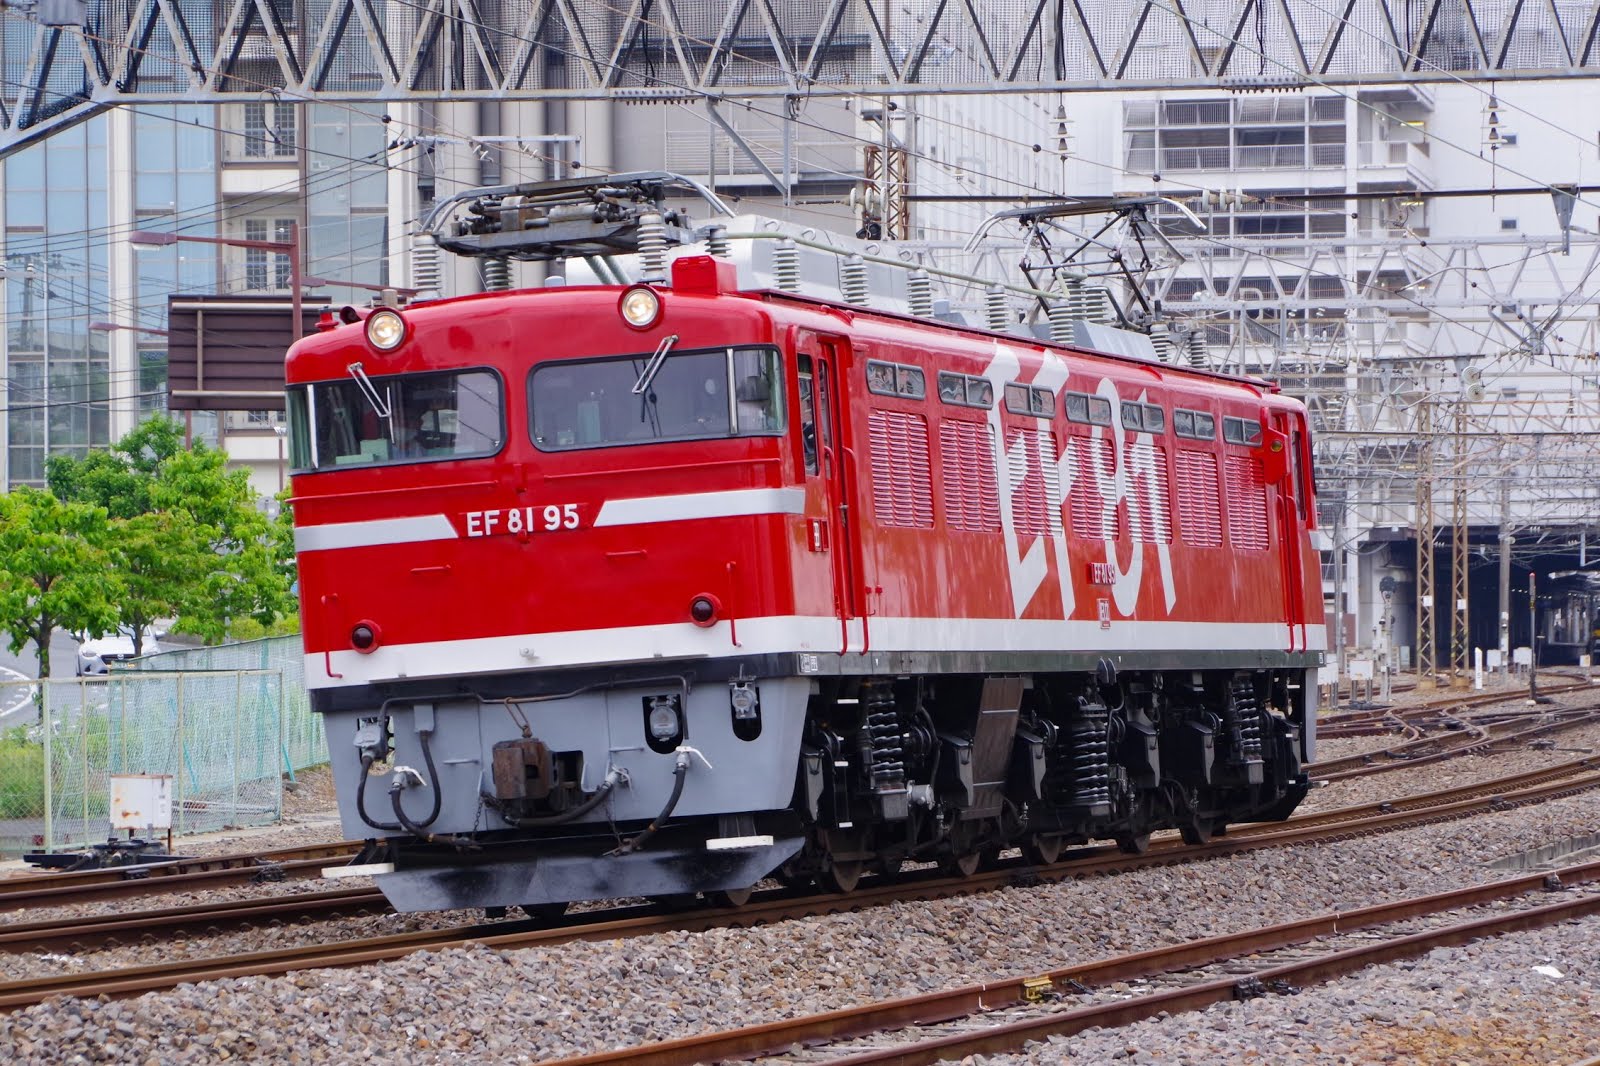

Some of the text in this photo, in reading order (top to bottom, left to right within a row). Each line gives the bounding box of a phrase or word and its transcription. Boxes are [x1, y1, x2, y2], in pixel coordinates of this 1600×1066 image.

[466, 503, 580, 537] EF 81 95
